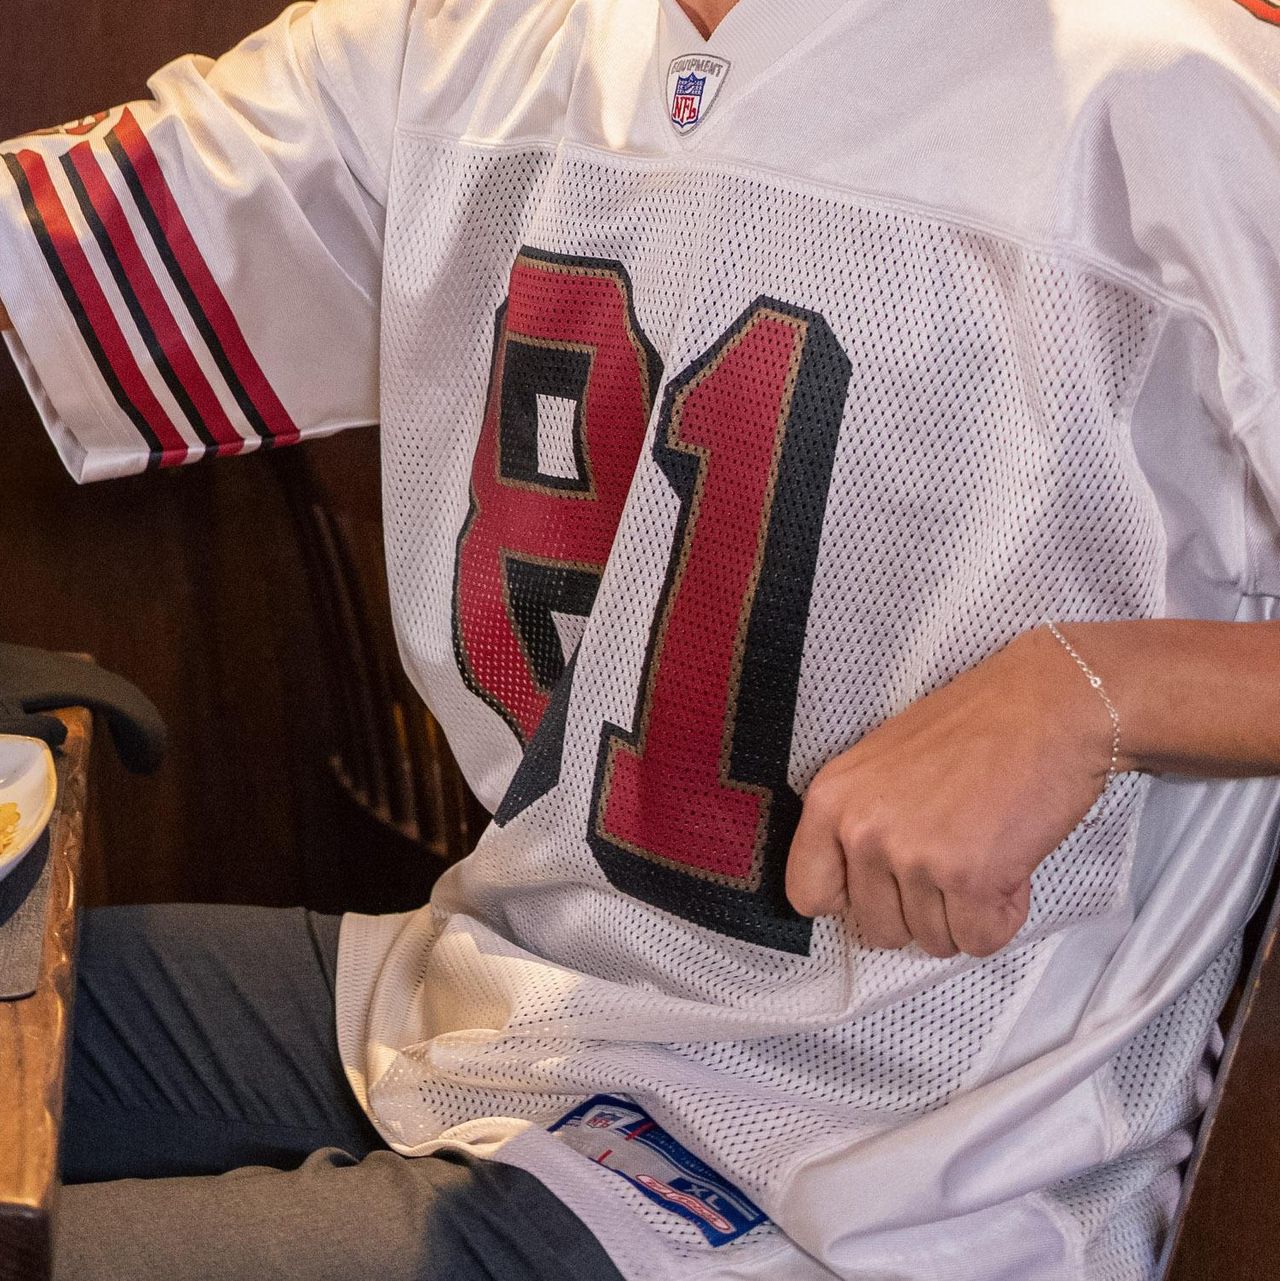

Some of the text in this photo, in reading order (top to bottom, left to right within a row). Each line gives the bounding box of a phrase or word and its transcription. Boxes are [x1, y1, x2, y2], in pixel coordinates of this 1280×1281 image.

[673, 96, 696, 123] NFL
[451, 244, 853, 958] 81
[685, 1183, 721, 1211] XL
